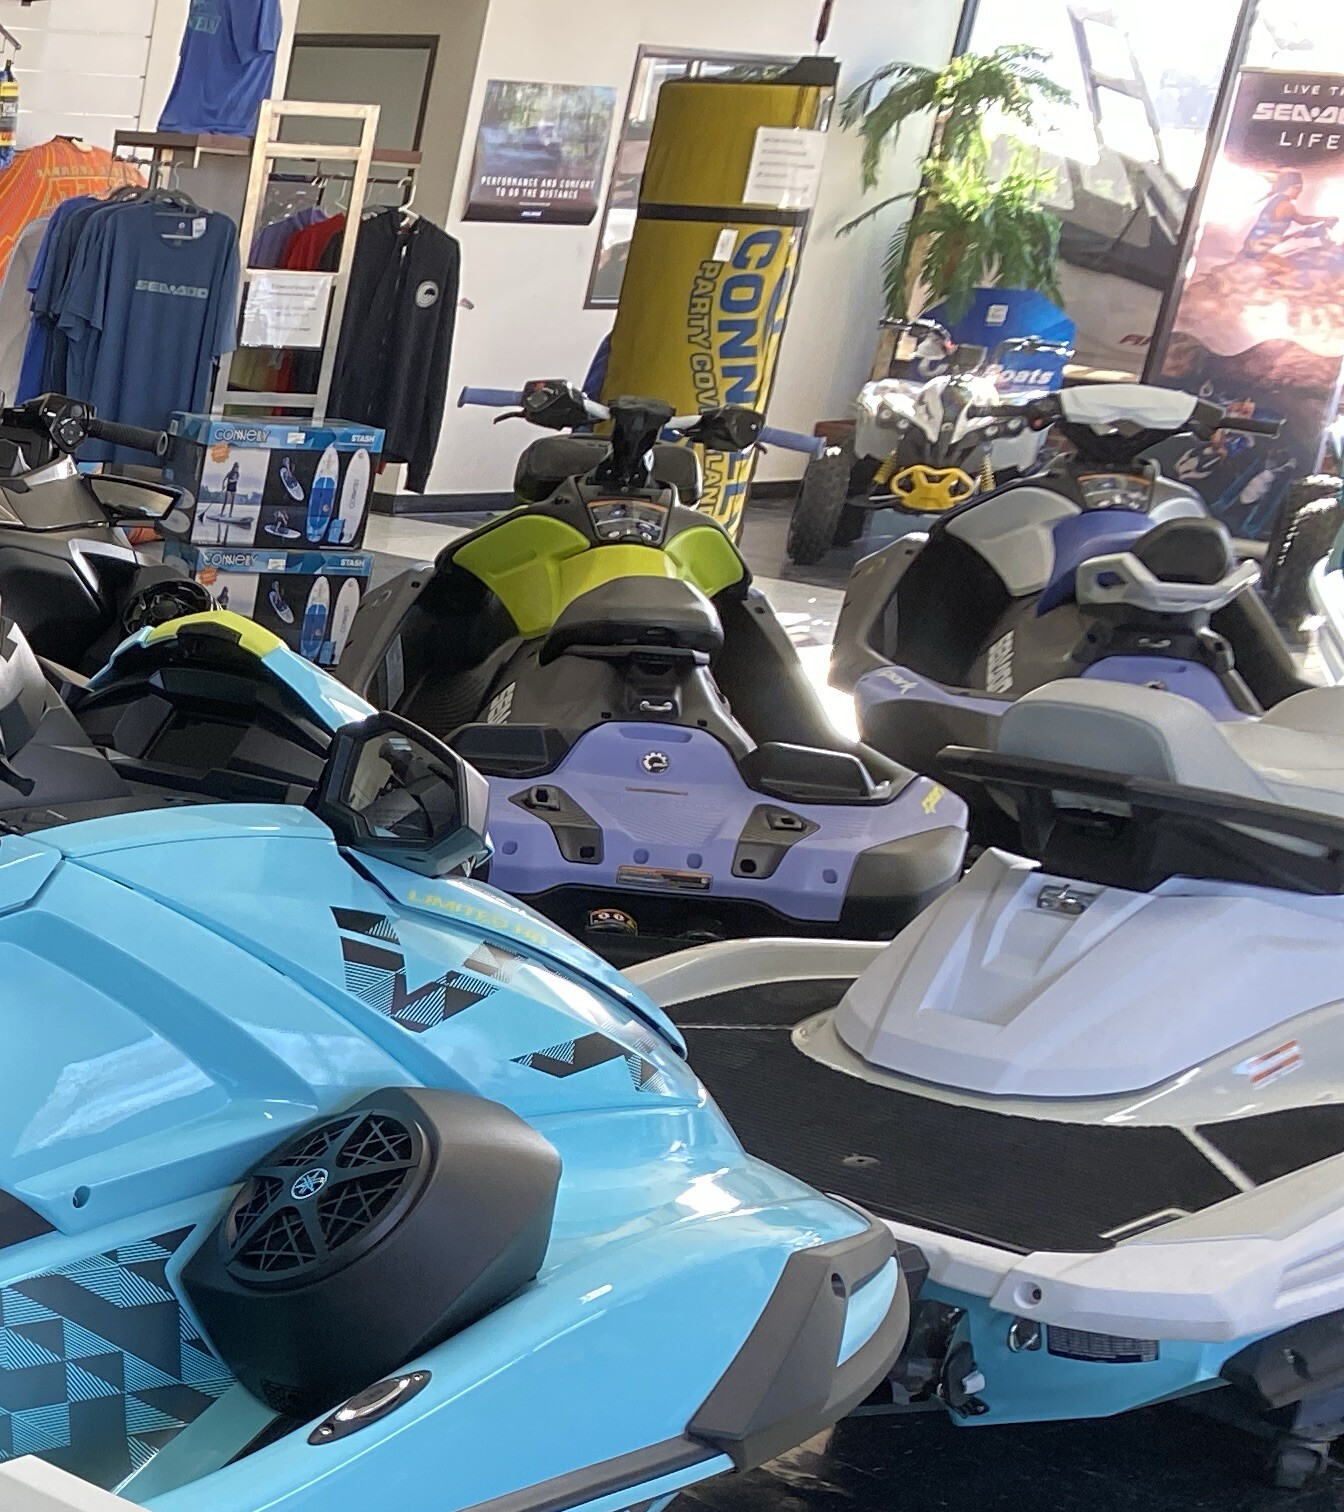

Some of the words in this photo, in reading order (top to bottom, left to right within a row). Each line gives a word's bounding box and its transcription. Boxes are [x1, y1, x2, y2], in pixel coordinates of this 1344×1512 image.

[1283, 83, 1322, 96] LIVE
[1278, 131, 1341, 150] LIFE
[480, 175, 539, 188] PERFORMANCE
[688, 259, 724, 350] PARTY
[350, 434, 376, 443] STASH
[340, 558, 365, 567] STASH
